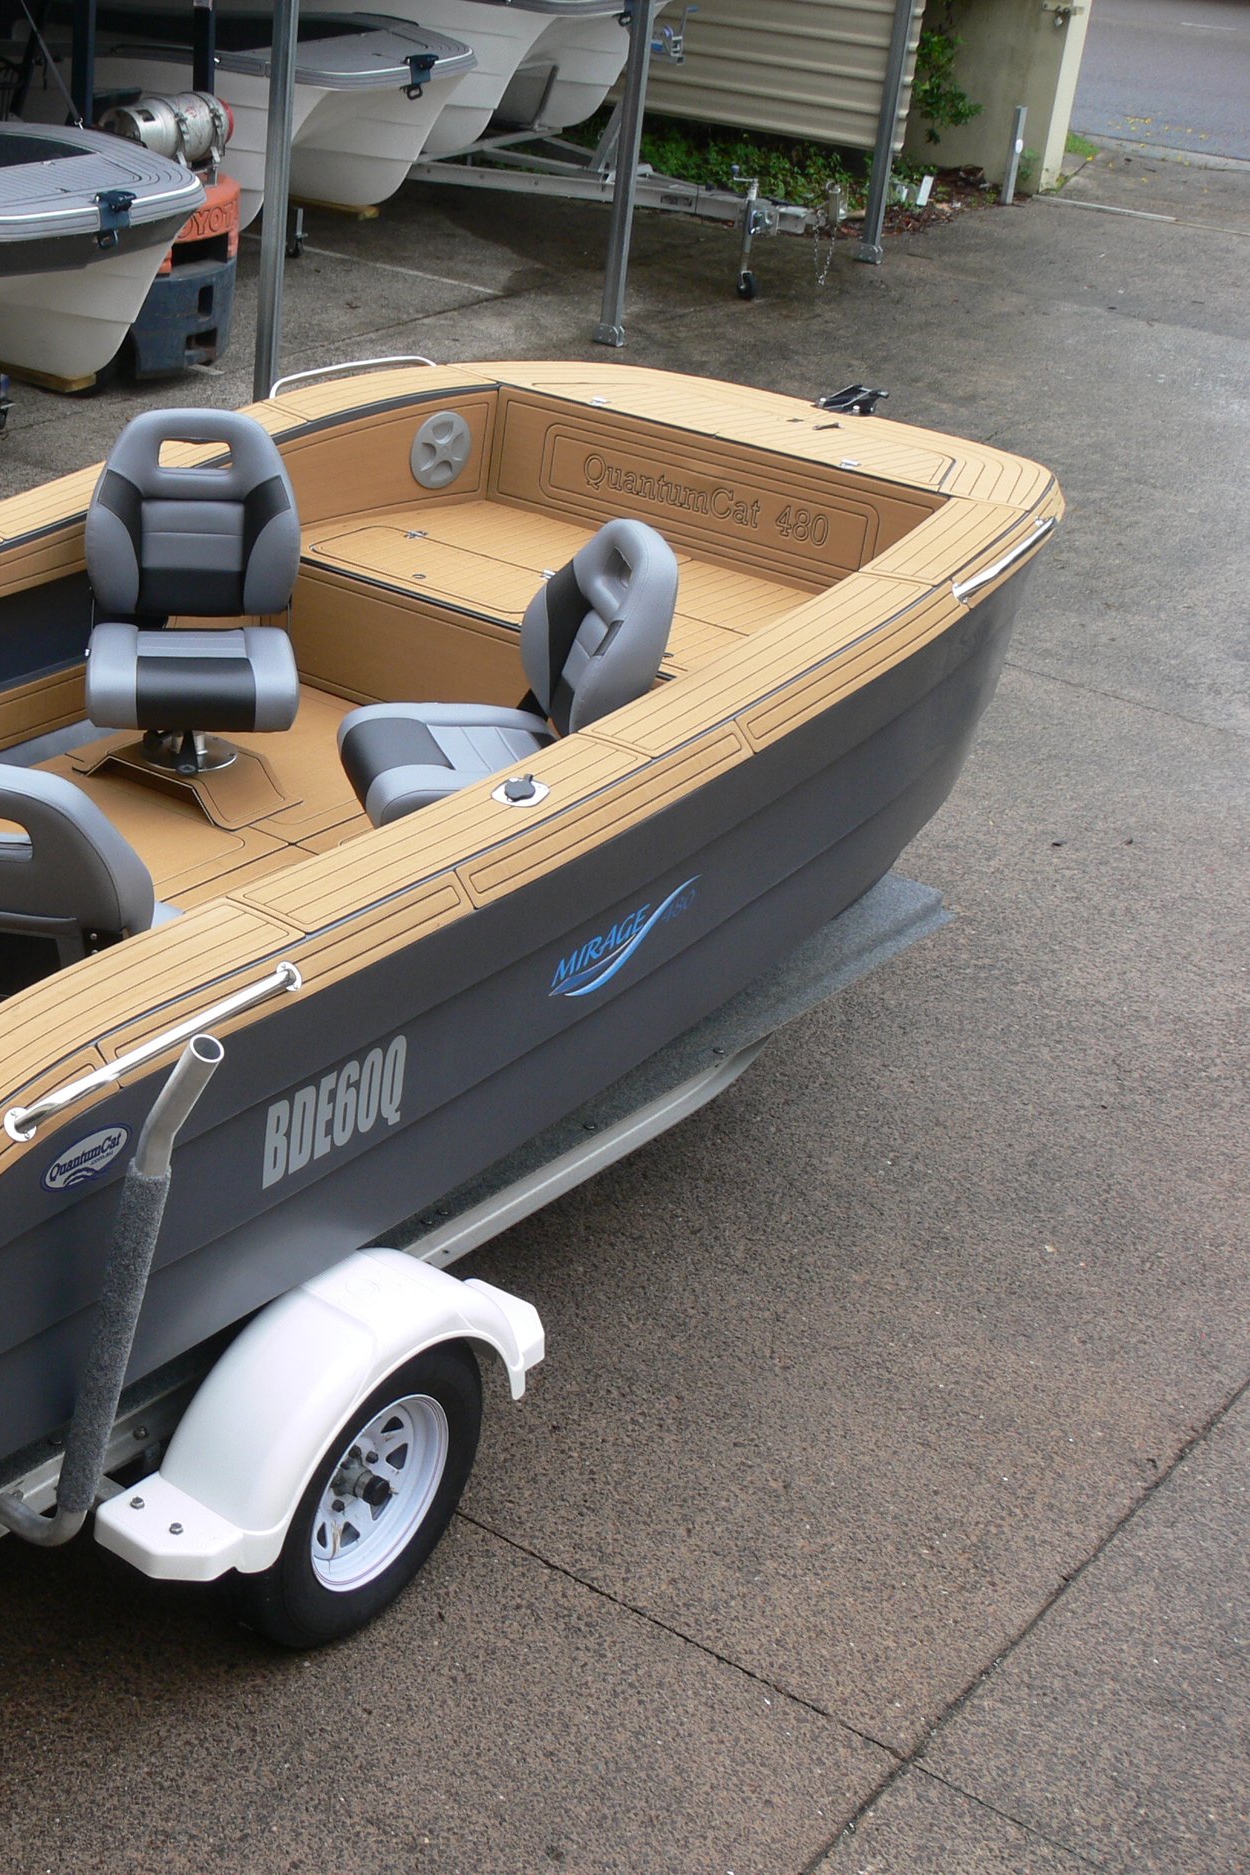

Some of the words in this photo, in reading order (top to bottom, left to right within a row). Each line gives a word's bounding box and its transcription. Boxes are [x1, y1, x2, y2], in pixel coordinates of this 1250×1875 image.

[583, 452, 761, 529] QuantumCat
[775, 504, 829, 547] 480
[551, 903, 651, 988] MIRAGE
[49, 1131, 123, 1182] QuantumCat
[262, 1034, 408, 1191] BDE60Q
